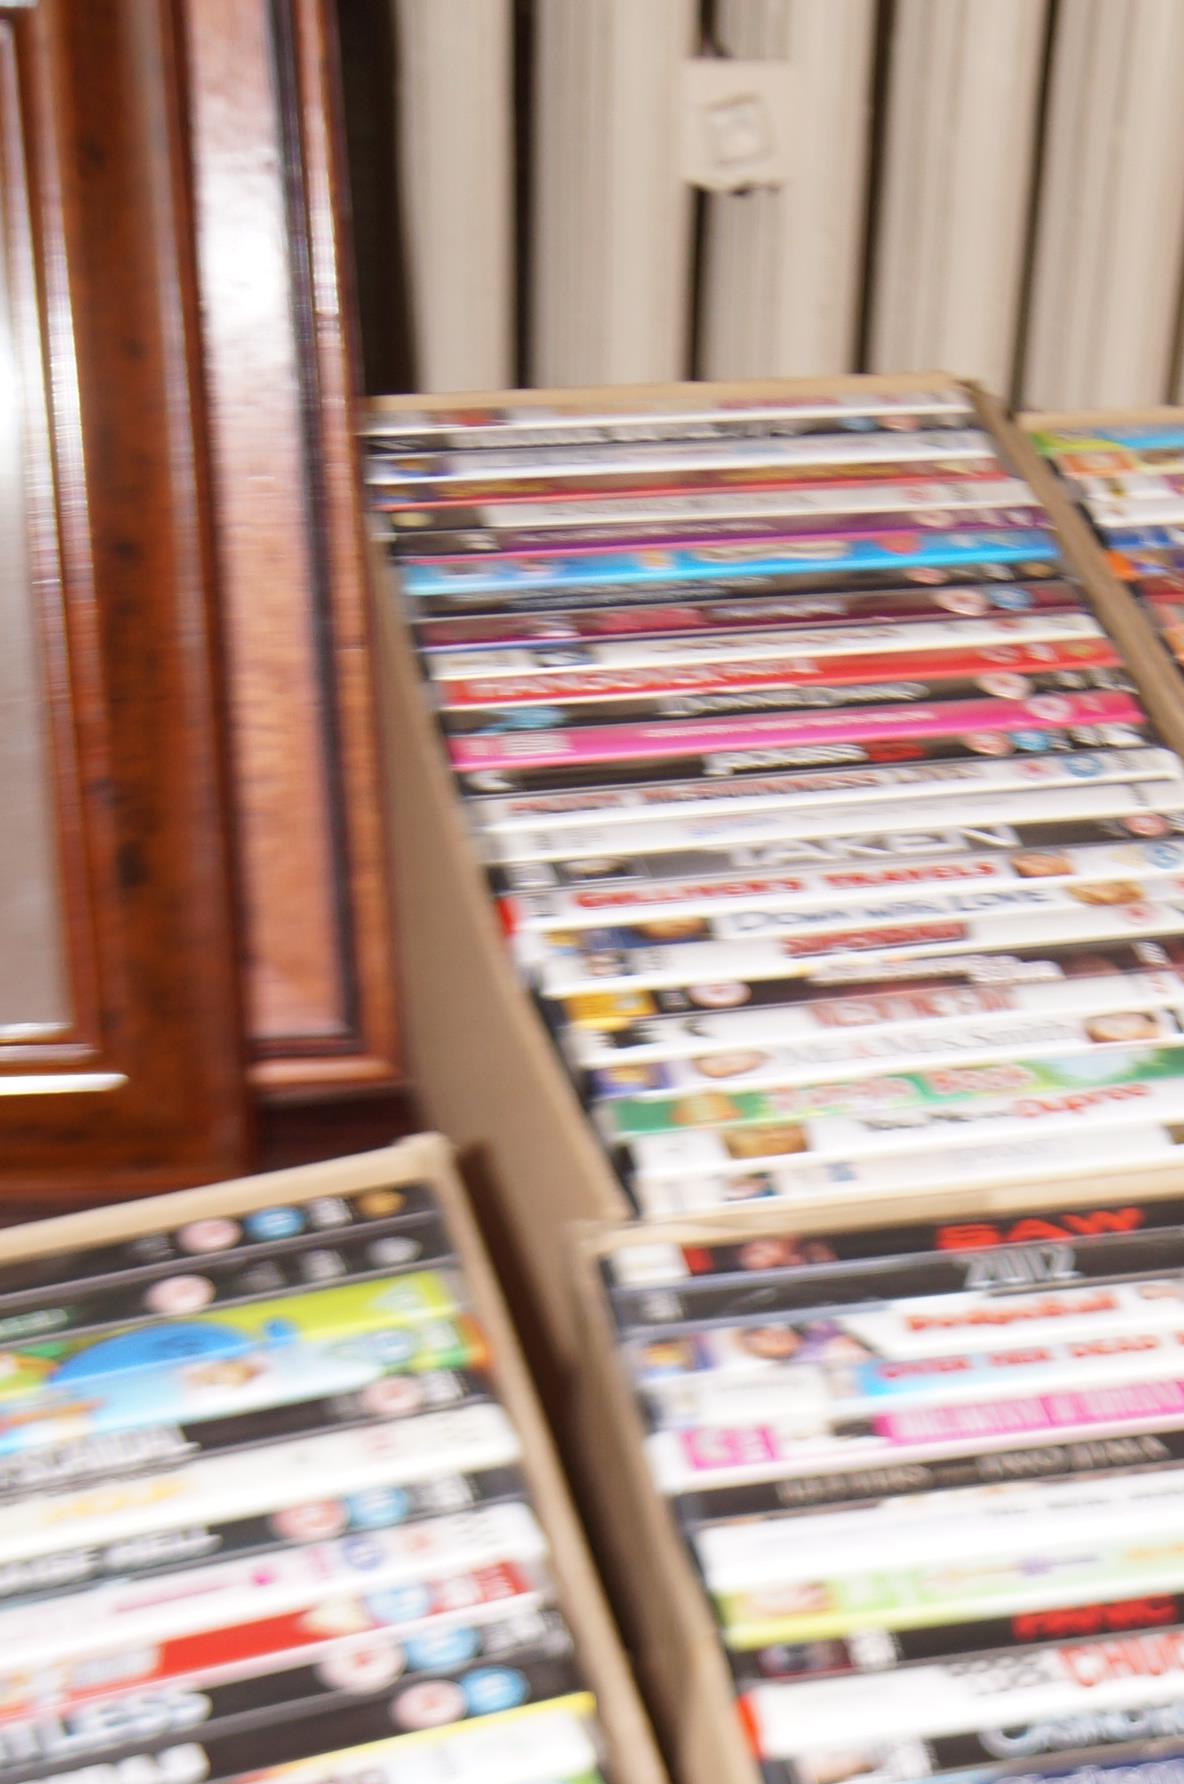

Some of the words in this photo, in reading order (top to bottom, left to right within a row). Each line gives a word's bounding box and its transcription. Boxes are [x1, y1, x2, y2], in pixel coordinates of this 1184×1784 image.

[727, 823, 1020, 868] TAKEN
[575, 878, 800, 910] GULLIVER'S
[822, 861, 996, 892] TRAVELS
[935, 1206, 1145, 1252] SAW
[1072, 1333, 1160, 1362] DEAD
